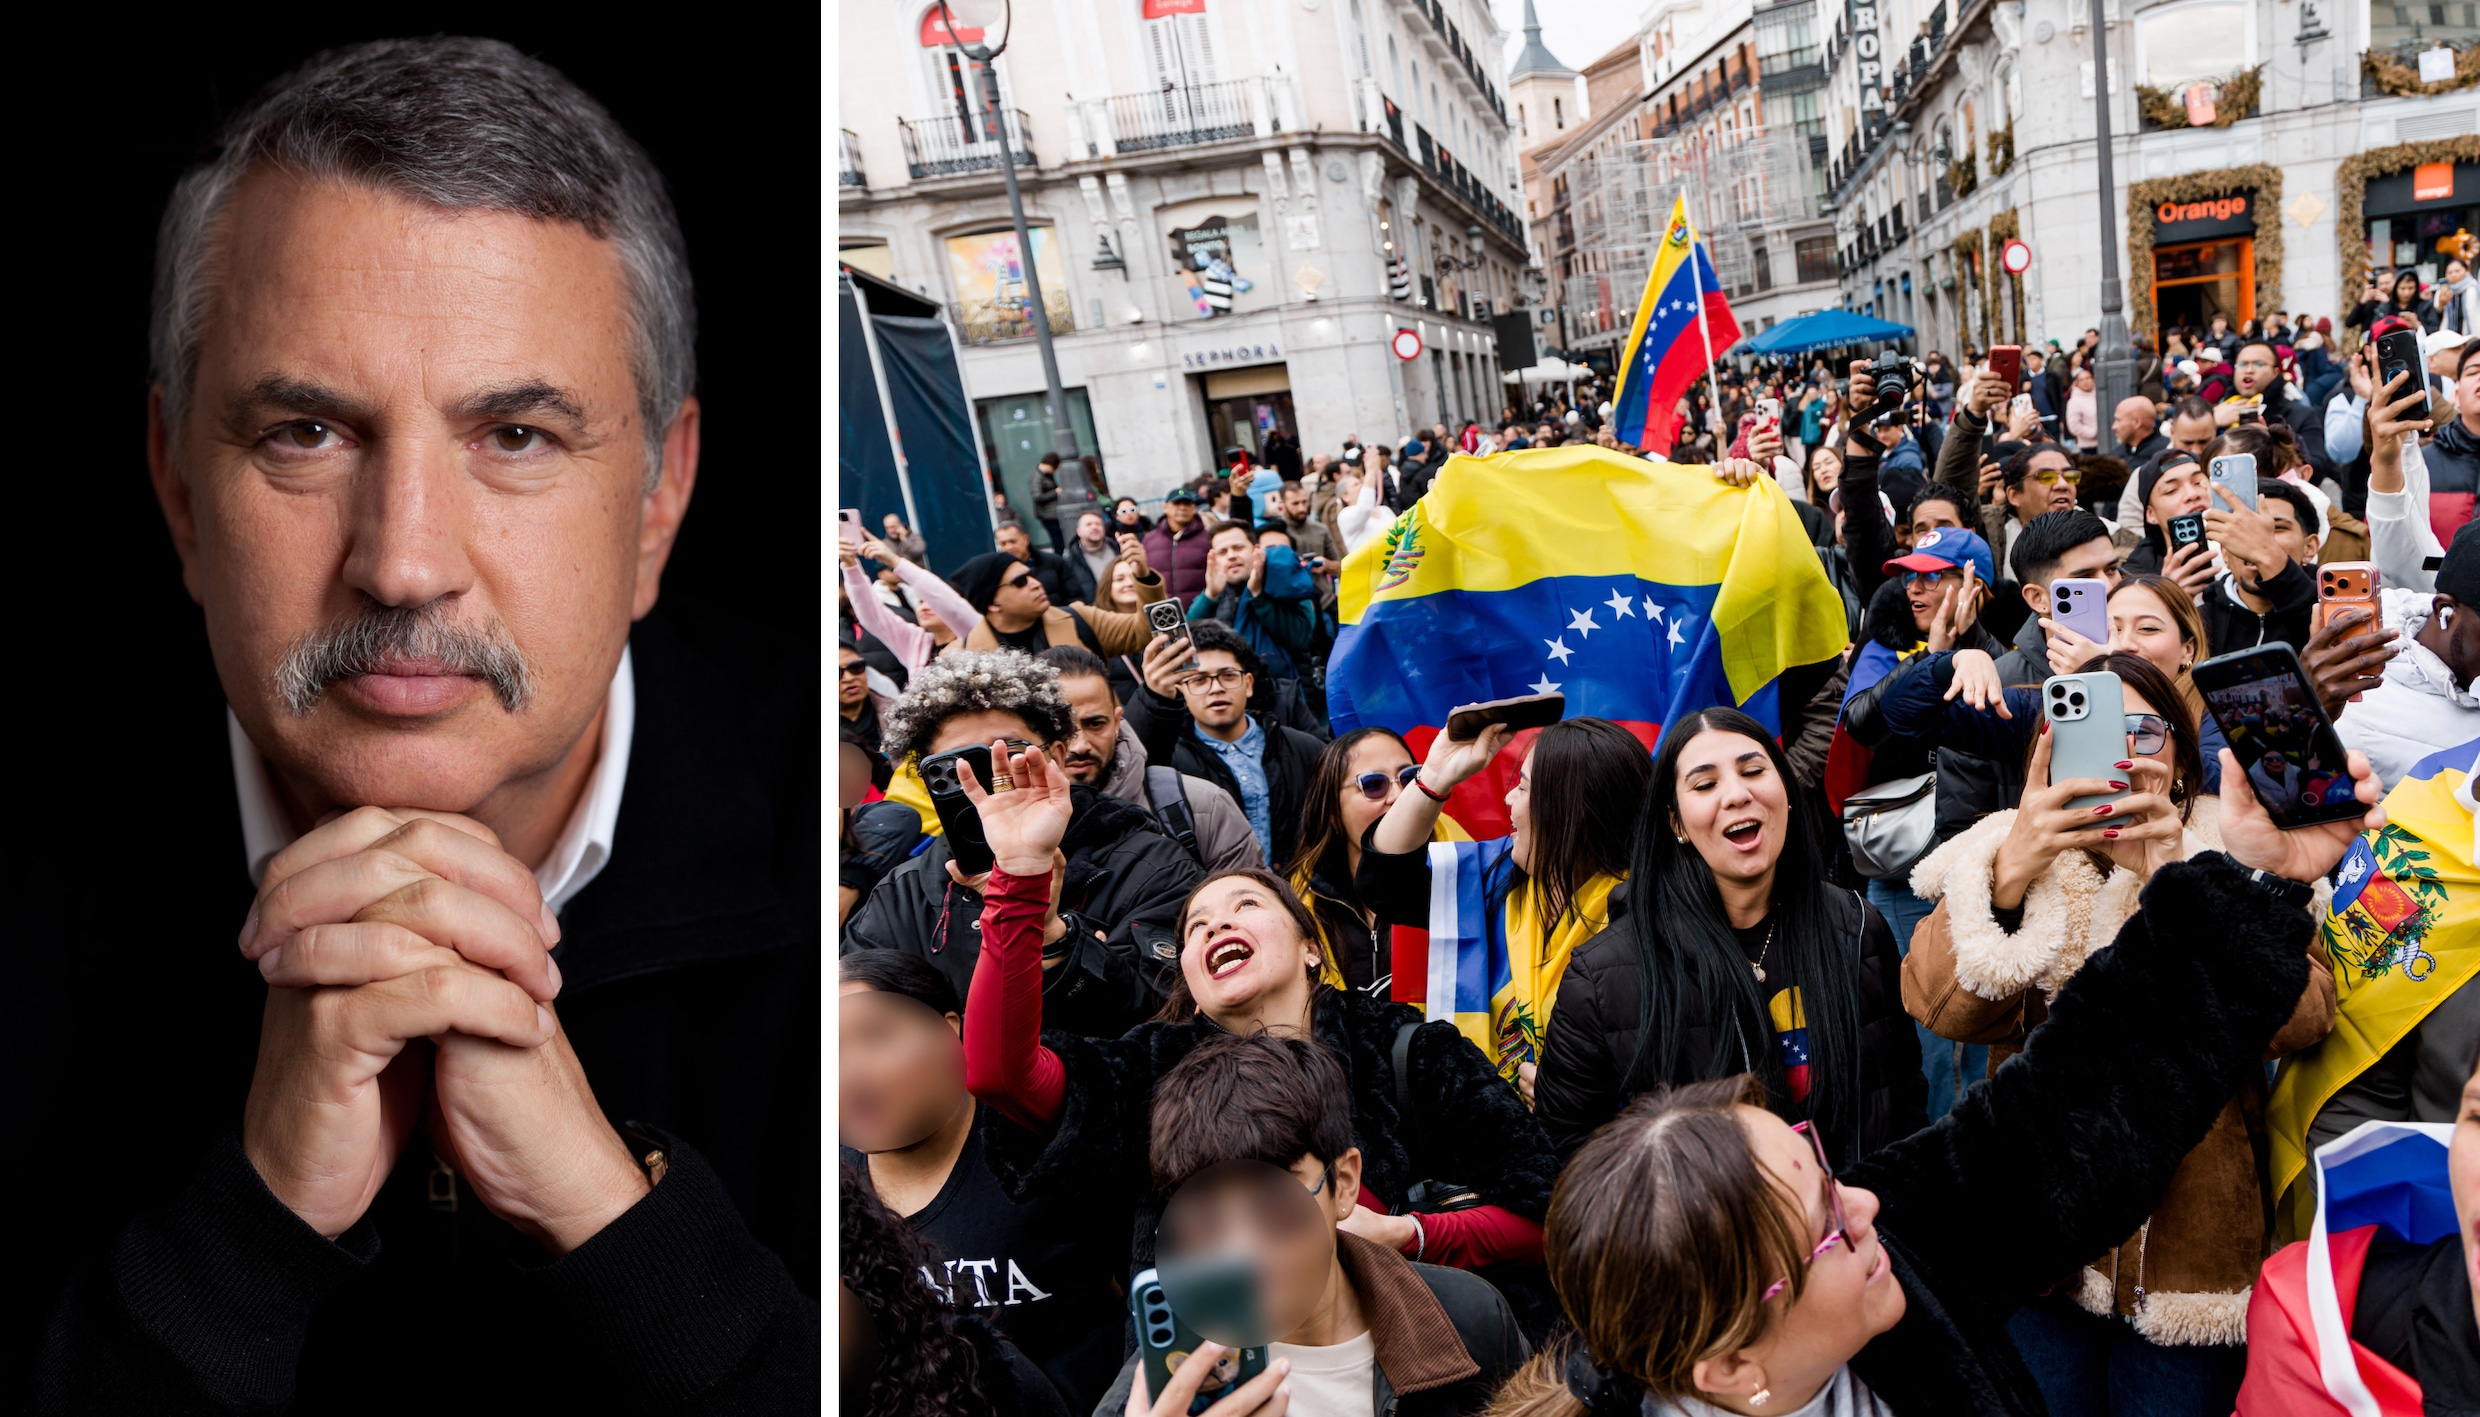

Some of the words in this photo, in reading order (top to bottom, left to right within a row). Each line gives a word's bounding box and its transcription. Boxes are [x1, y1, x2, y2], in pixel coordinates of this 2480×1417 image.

[1854, 0, 1884, 112] ROPA
[2157, 196, 2247, 224] Orange
[1183, 343, 1279, 367] SEPHORA
